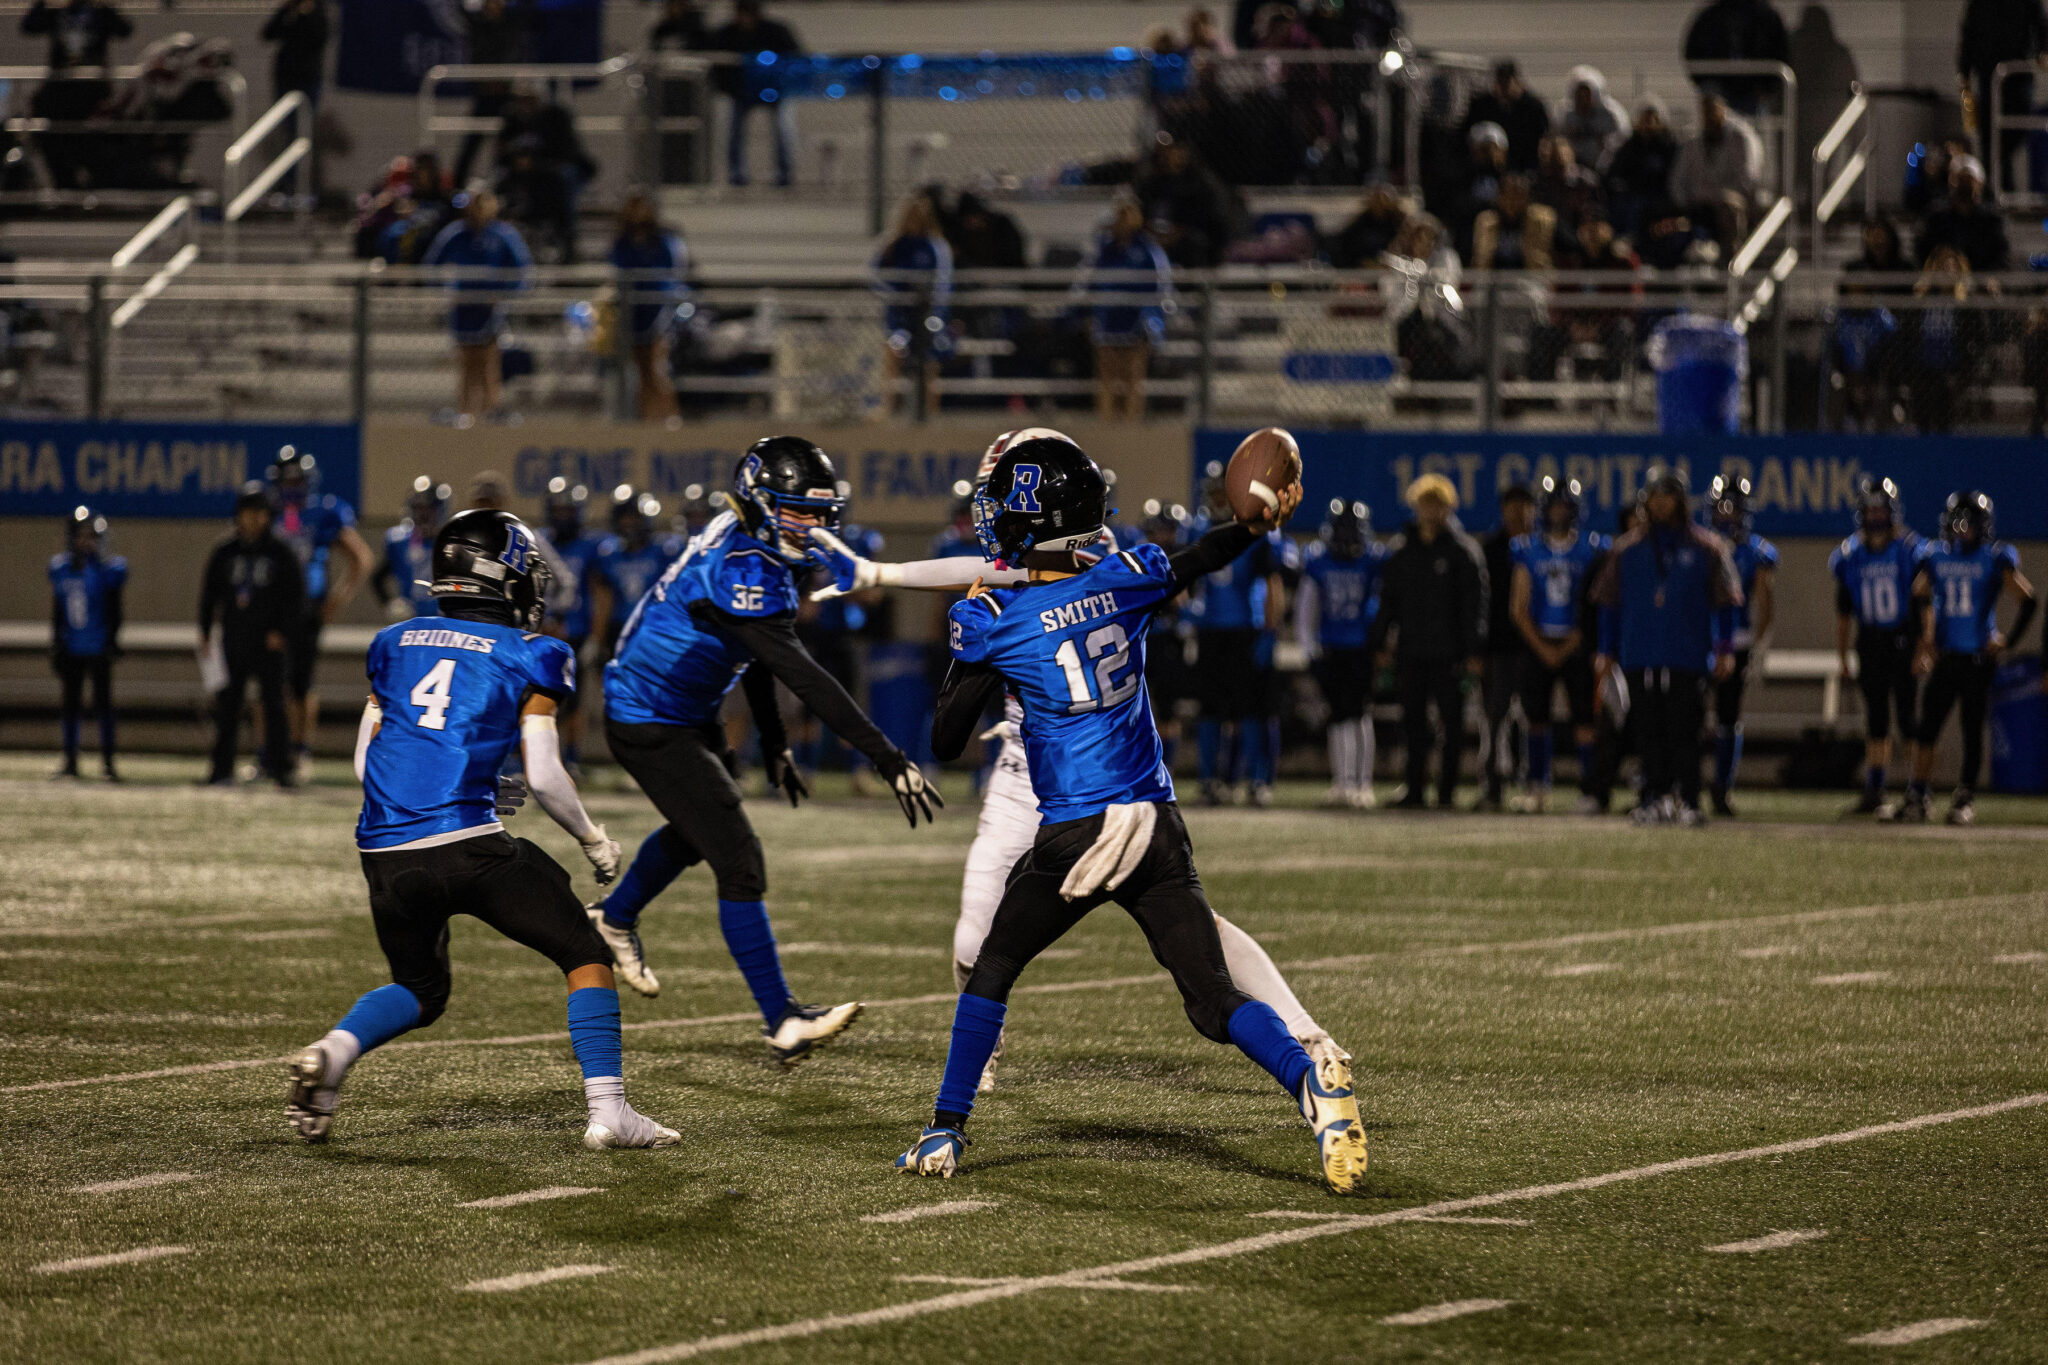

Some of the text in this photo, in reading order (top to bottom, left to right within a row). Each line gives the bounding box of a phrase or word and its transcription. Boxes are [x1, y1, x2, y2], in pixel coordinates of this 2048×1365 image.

[75, 441, 247, 493] CHAPIN
[862, 452, 981, 498] FAM
[1009, 463, 1042, 513] R
[498, 522, 533, 576] R
[731, 583, 765, 611] 32
[1039, 591, 1119, 634] SMITH
[1861, 577, 1899, 624] 10
[1945, 577, 1974, 617] 11
[399, 629, 497, 654] BRIONES
[1054, 622, 1138, 714] 12
[410, 658, 457, 731] 4
